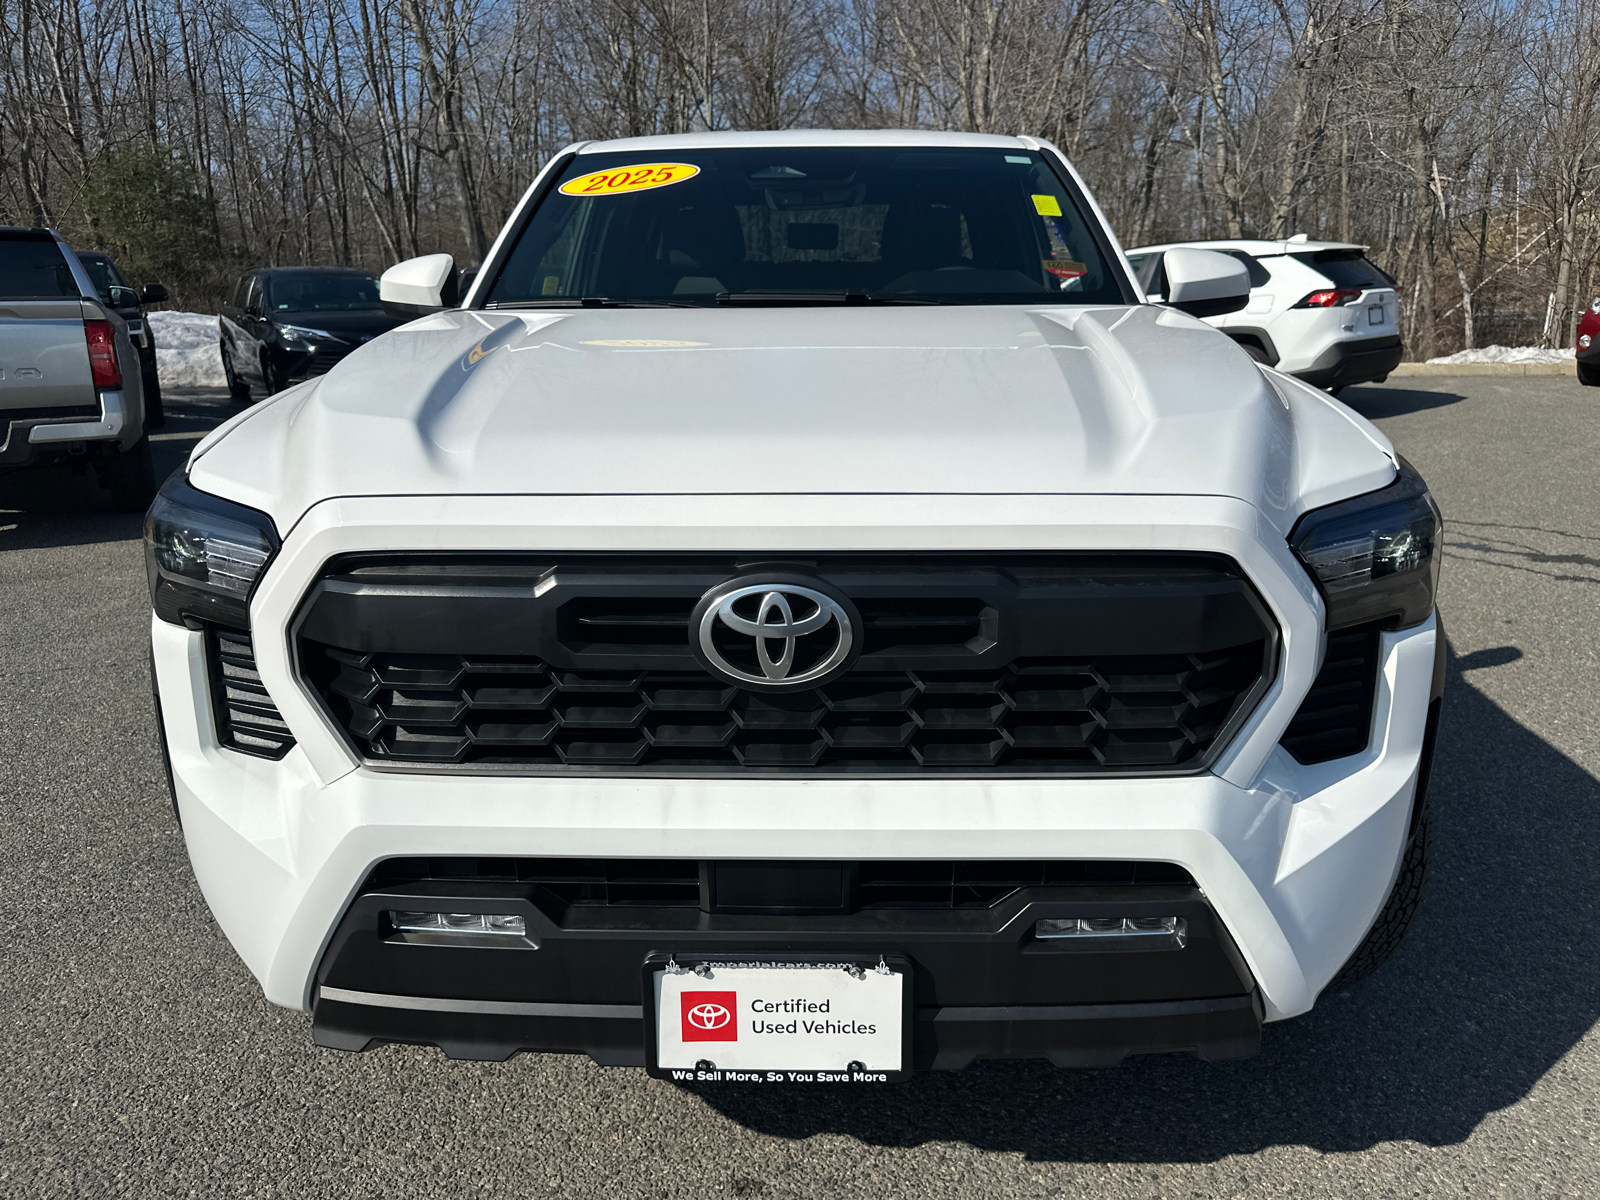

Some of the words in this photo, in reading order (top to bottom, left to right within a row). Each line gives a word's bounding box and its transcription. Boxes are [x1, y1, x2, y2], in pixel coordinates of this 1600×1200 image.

[582, 166, 677, 192] 2025
[751, 999, 830, 1013] Certified
[752, 1020, 797, 1034] Used
[802, 1020, 876, 1034] Vehicles
[672, 1071, 694, 1081] We
[697, 1071, 722, 1081] Sell
[726, 1072, 763, 1083] More,
[767, 1072, 784, 1082] So
[787, 1072, 814, 1082] You
[818, 1072, 850, 1082] Save
[854, 1072, 887, 1082] More
